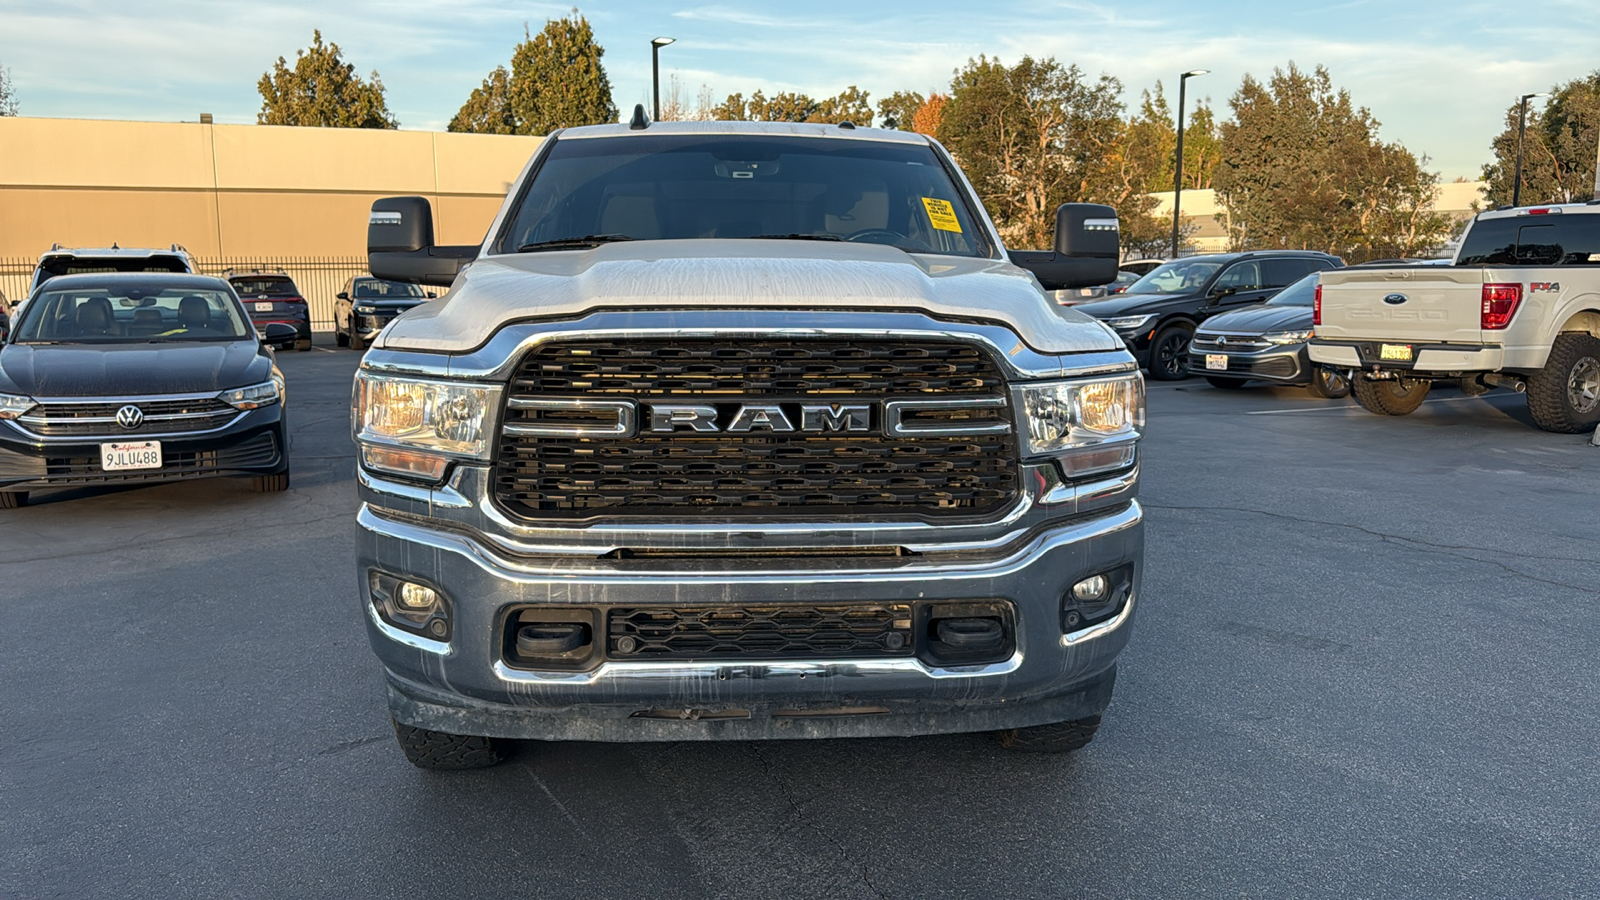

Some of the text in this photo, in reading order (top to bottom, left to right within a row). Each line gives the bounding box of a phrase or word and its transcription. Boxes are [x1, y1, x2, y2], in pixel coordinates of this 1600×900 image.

[1530, 282, 1560, 293] FX4
[1346, 308, 1448, 321] F-150
[651, 404, 871, 432] RAM
[106, 451, 158, 467] 9JLU488
